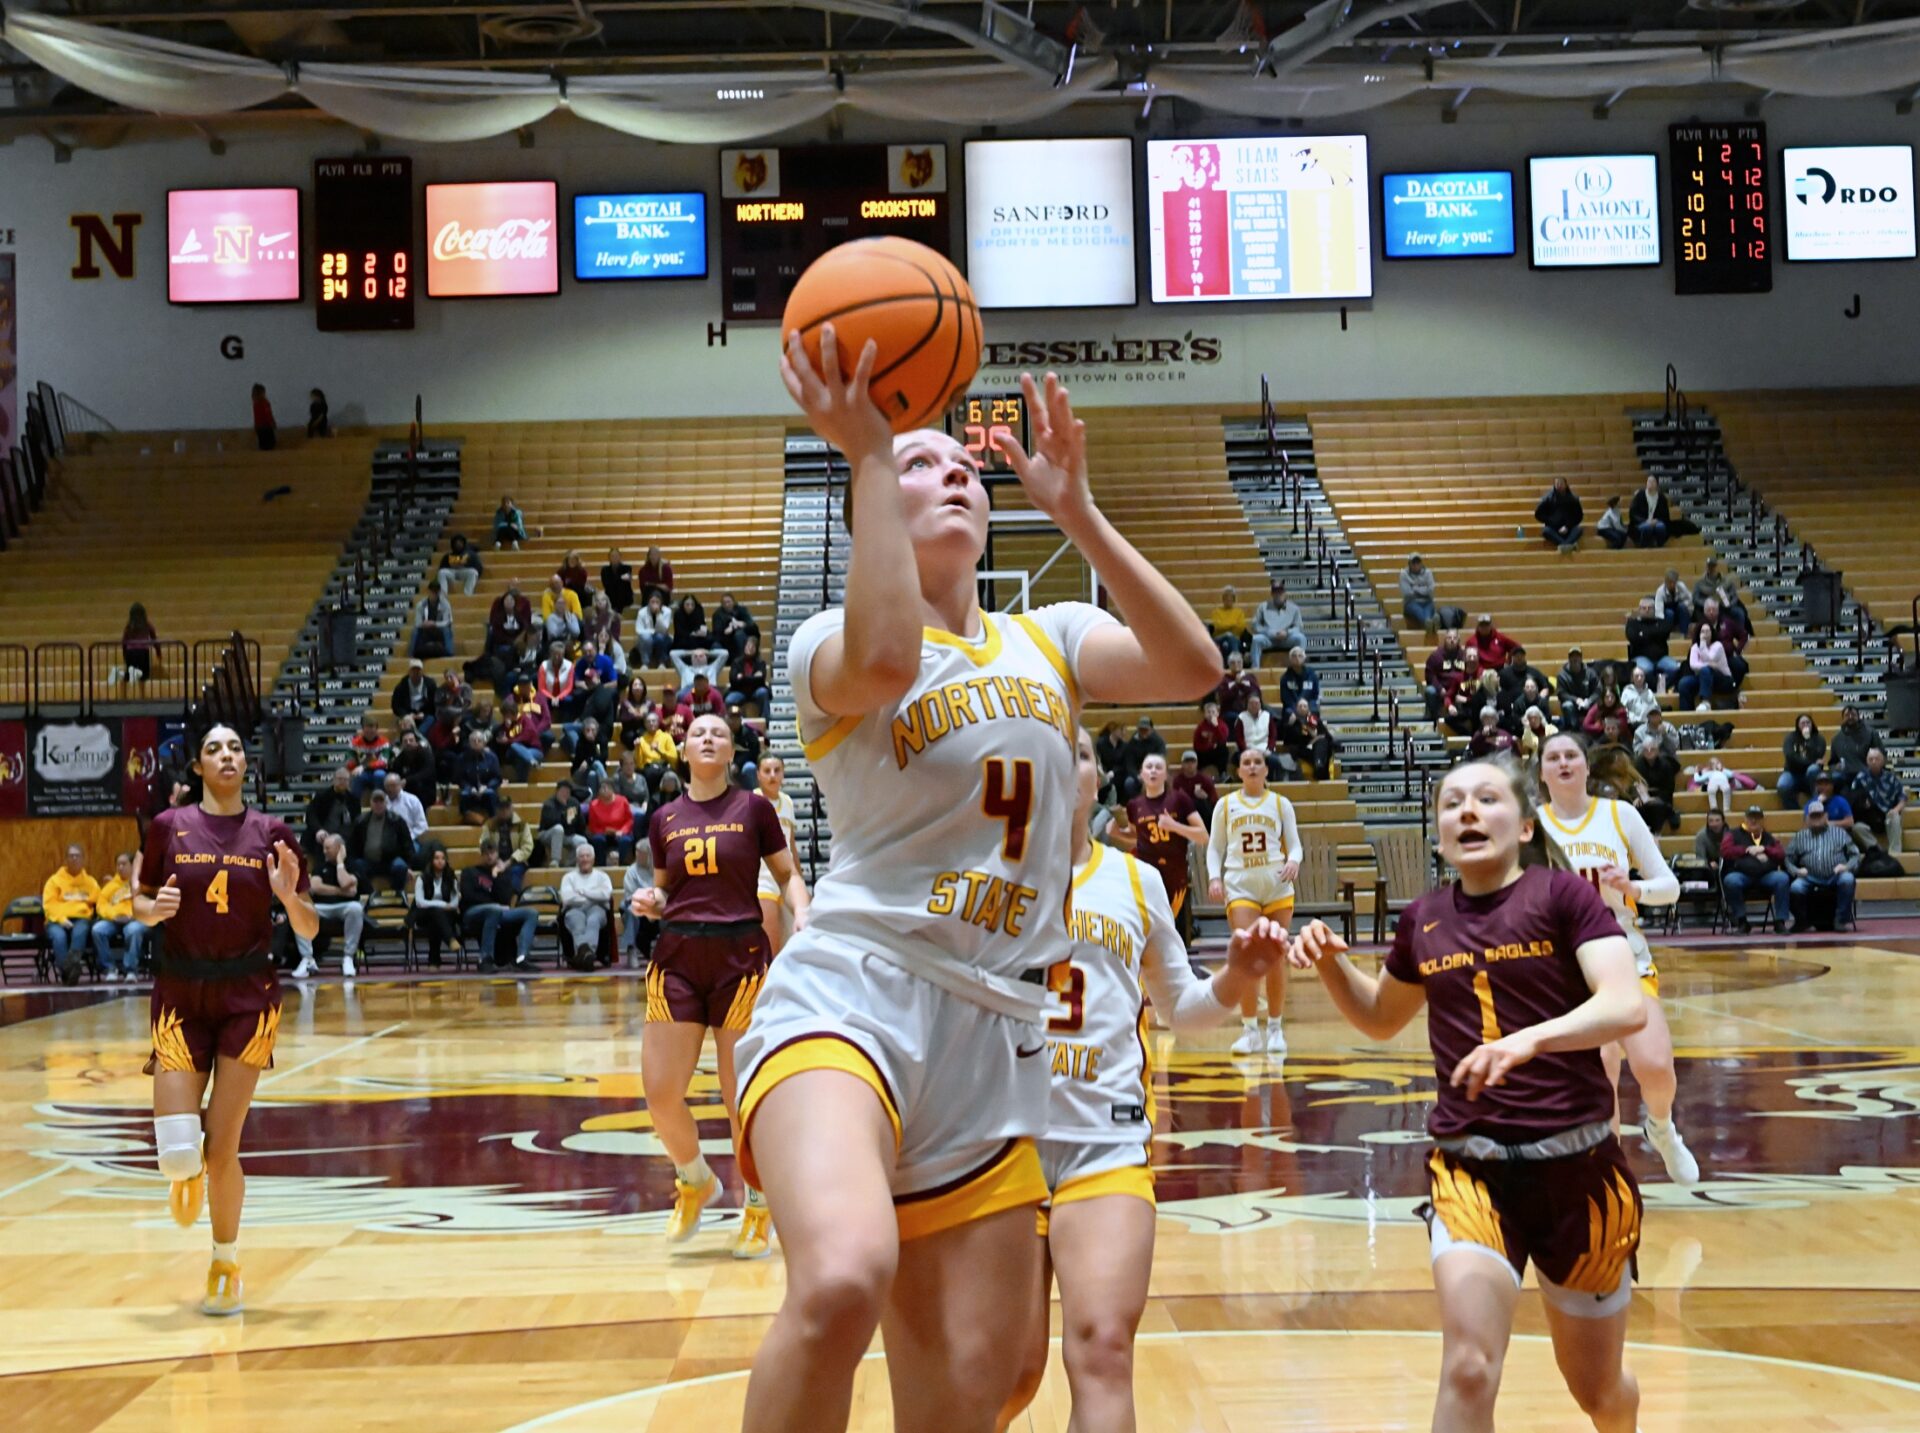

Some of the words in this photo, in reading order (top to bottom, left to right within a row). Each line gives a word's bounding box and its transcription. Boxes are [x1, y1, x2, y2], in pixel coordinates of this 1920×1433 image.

[1720, 144, 1731, 163] 2
[1751, 143, 1761, 161] 7
[1407, 179, 1489, 197] DACOTAH
[1692, 169, 1704, 186] 4
[1721, 169, 1733, 186] 4
[1745, 168, 1762, 186] 12
[598, 201, 682, 217] DACOTAH
[736, 202, 804, 222] NORTHERN
[861, 199, 937, 219] CROOKSTON
[993, 204, 1109, 223] SANFORD
[1561, 188, 1653, 220] LAMONT
[1688, 192, 1705, 212] 10
[1746, 191, 1763, 211] 10
[990, 224, 1113, 237] ORTHOPEDICS
[1405, 231, 1437, 246] Here
[1438, 230, 1459, 247] for
[1540, 214, 1652, 243] COMPANIES
[1682, 217, 1706, 237] 21
[1753, 216, 1764, 233] 9
[70, 212, 143, 280] N
[213, 225, 254, 264] N
[974, 237, 1041, 249] SPORTS
[1047, 235, 1131, 248] MEDICINE
[1684, 241, 1707, 261] 30
[1749, 240, 1765, 259] 12
[321, 252, 348, 276] 23
[364, 252, 377, 275] 2
[394, 251, 407, 274] 0
[596, 252, 627, 267] Here
[628, 252, 650, 269] for
[322, 277, 348, 301] 34
[364, 277, 377, 300] 0
[387, 276, 407, 299] 12
[1844, 293, 1861, 319] J
[707, 322, 728, 347] H
[220, 335, 245, 361] G
[983, 331, 1222, 368] ESSLER'S
[1125, 371, 1187, 383] GROCER
[891, 676, 1076, 771] NORTHERN
[42, 735, 110, 765] Karisma
[981, 755, 1034, 864] 4
[666, 826, 700, 843] GOLDEN
[704, 823, 744, 834] EAGLES
[1147, 822, 1170, 844] 30
[1241, 831, 1267, 854] 23
[175, 853, 216, 865] GOLDEN
[223, 855, 263, 870] EAGLES
[683, 836, 719, 876] 21
[1561, 841, 1619, 865] THERN
[206, 869, 230, 914] 4
[928, 871, 1037, 938] STATE
[1068, 909, 1134, 969] HERN
[1418, 951, 1475, 977] GOLDEN
[1484, 940, 1554, 963] EAGLES
[1472, 970, 1503, 1045] 1
[1048, 1040, 1104, 1082] ATE
